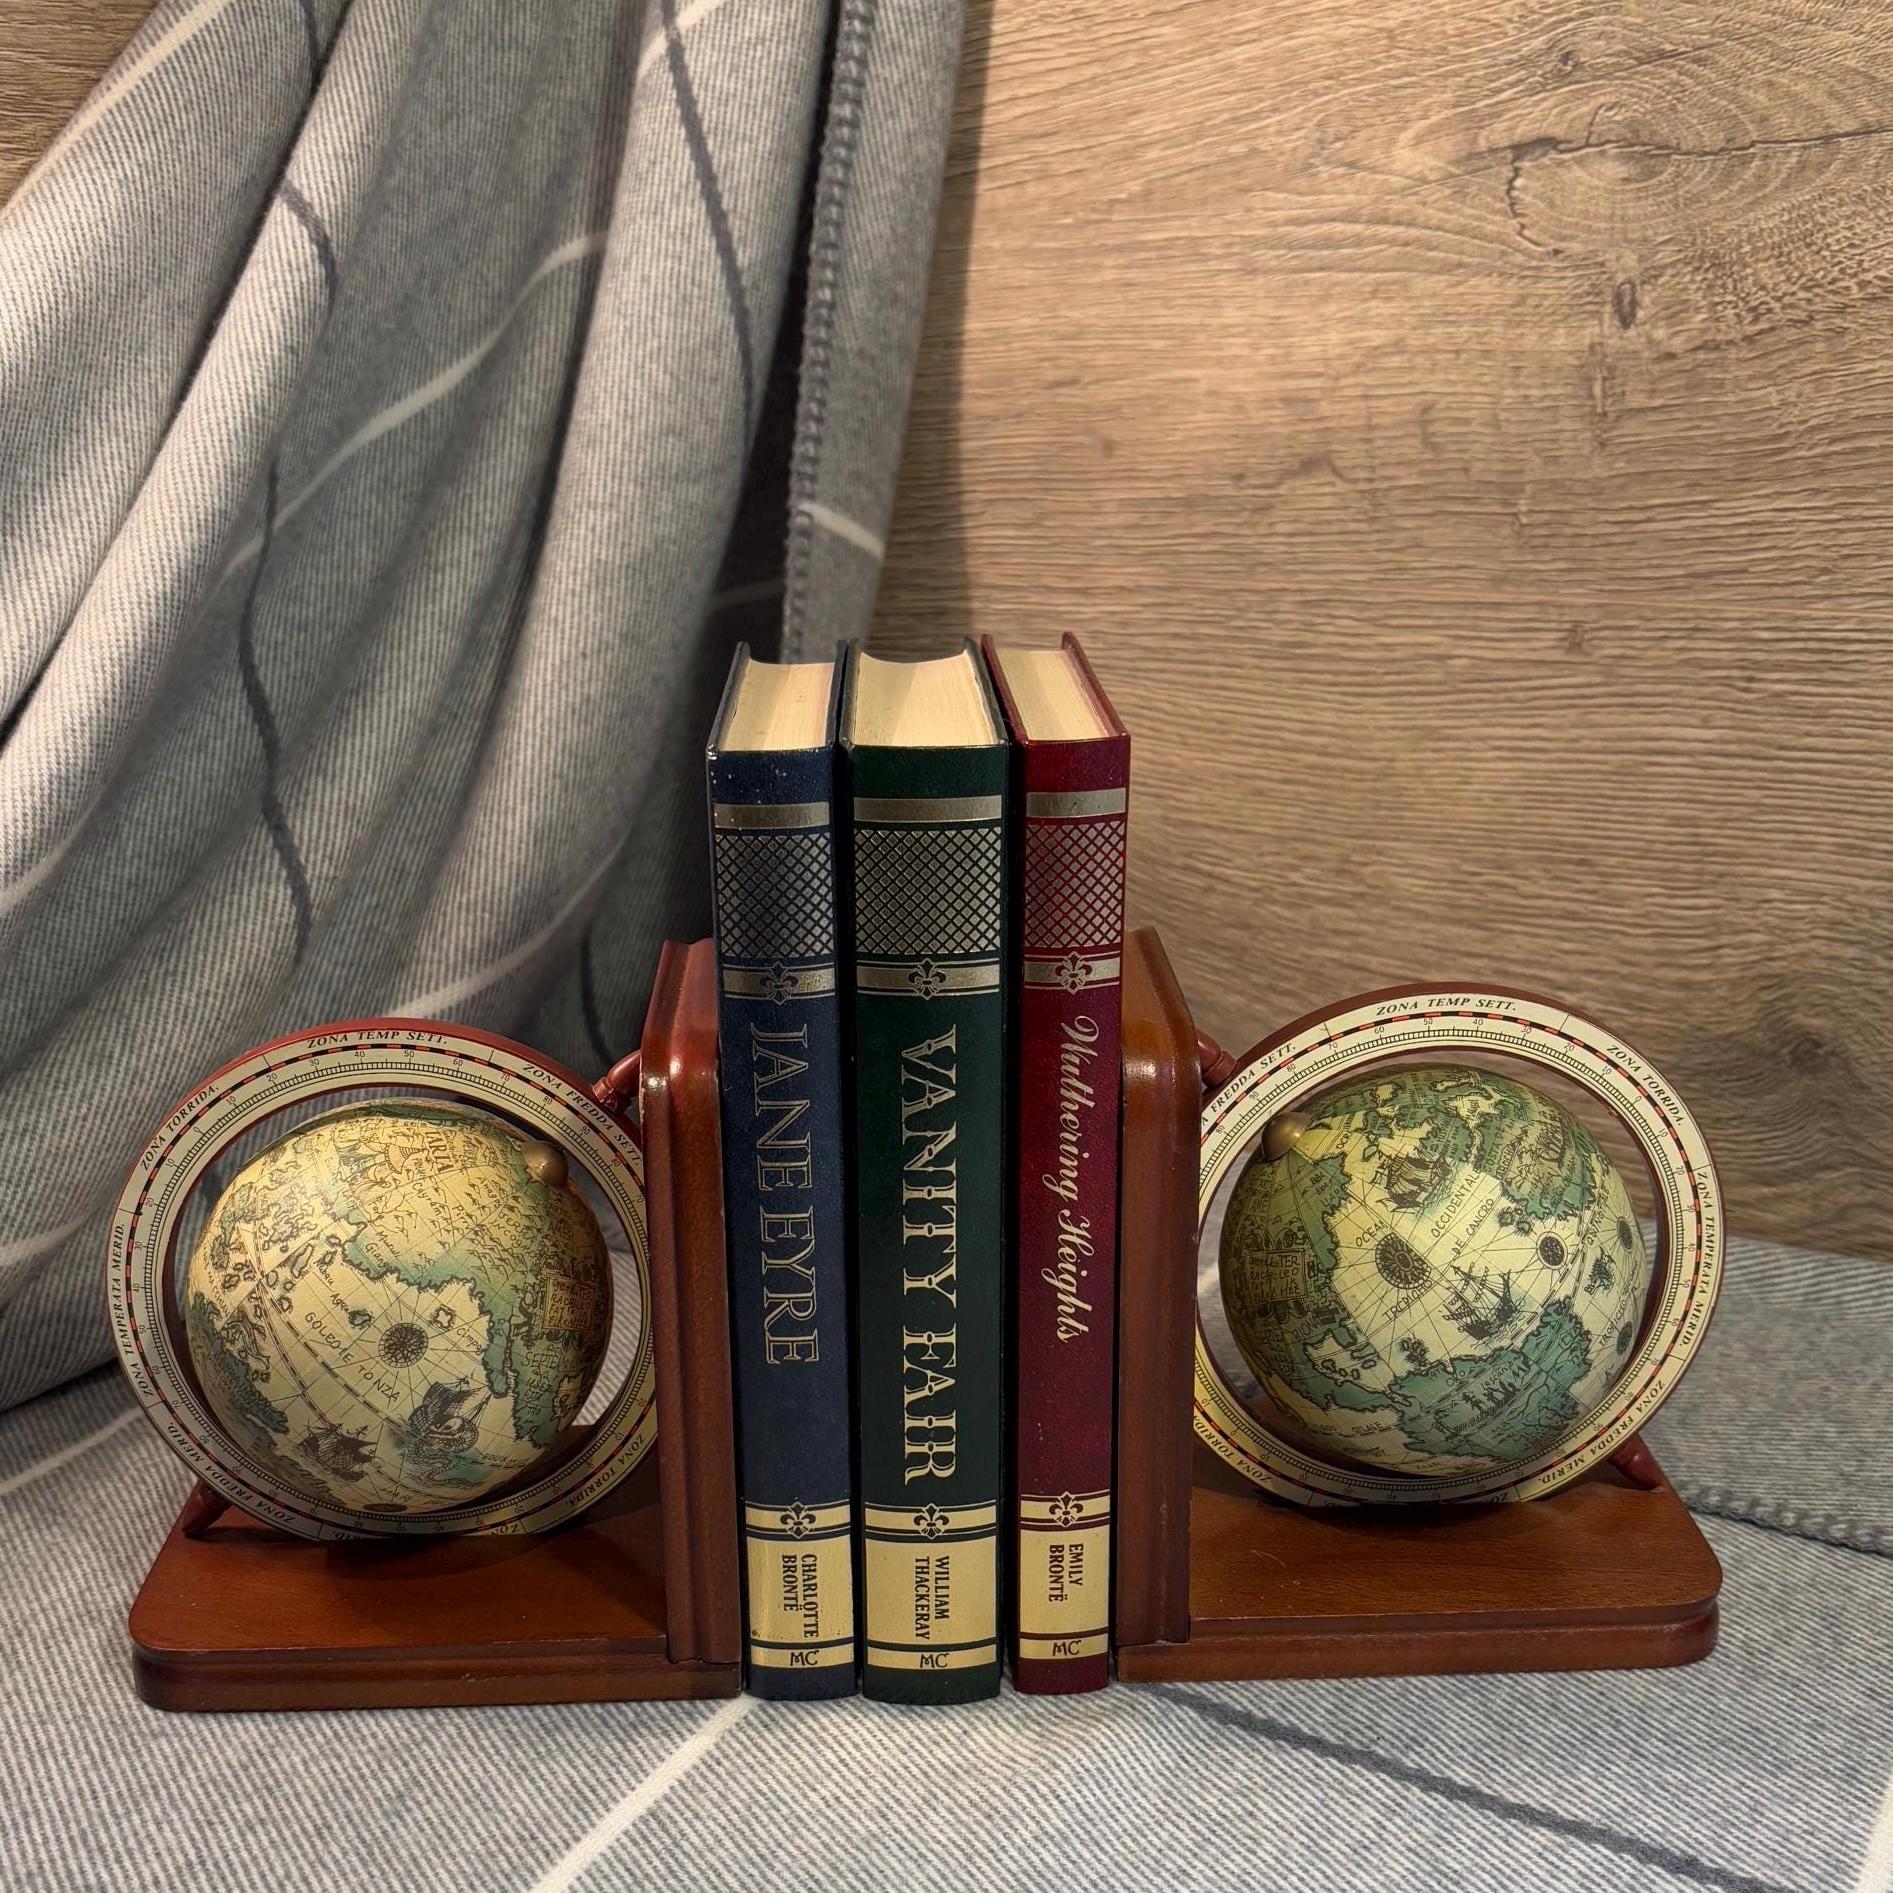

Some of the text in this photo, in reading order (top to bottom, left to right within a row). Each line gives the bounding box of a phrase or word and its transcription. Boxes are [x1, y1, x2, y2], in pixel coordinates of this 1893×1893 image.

[1376, 998, 1517, 1016] ZONA TEMP SETT.
[1423, 1018, 1433, 1026] 50
[1473, 1018, 1484, 1026] 40
[1374, 1026, 1385, 1034] 60
[1521, 1026, 1532, 1034] 30
[307, 1030, 448, 1049] ZONA TEMP SETT.
[1564, 1043, 1575, 1051] 20
[354, 1051, 366, 1059] 40
[404, 1050, 415, 1058] 50
[453, 1059, 463, 1067] 60
[1287, 1063, 1297, 1072] 80
[1602, 1066, 1612, 1075] 10
[266, 1073, 278, 1082] 20
[501, 1073, 510, 1081] 70
[1210, 1042, 1296, 1113] FREDDA SETT.
[1606, 1044, 1685, 1126] ZONA TORRIDA.
[226, 1095, 236, 1105] 10
[544, 1096, 553, 1104] 80
[1249, 1091, 1259, 1100] 90
[522, 1063, 641, 1166] ZONA FREDDA SETT.
[140, 1085, 220, 1172] ZONA TORRIDA.
[582, 1126, 591, 1135] 90
[1215, 1125, 1225, 1134] 80
[1659, 1128, 1668, 1137] 10
[165, 1158, 175, 1168] 10
[1676, 1166, 1685, 1176] 20
[1042, 1015, 1099, 1344] Wuthering Heights
[751, 1022, 819, 1364] JANE EYRE
[146, 1197, 154, 1207] 20
[134, 1241, 143, 1250] 30
[1688, 1243, 1696, 1252] 40
[902, 1024, 956, 1486] VANITY FAIR
[1680, 1171, 1715, 1347] ZONA TEMPERATA MERID.
[133, 1283, 140, 1293] 40
[1684, 1279, 1691, 1289] 50
[111, 1223, 154, 1398] ZONA TEMPERATA MERID.
[1672, 1318, 1680, 1327] 60
[140, 1324, 147, 1334] 50
[1538, 1379, 1665, 1484] ZONA FREDDA MERID.
[167, 1422, 297, 1522] ZONA FREDDA MERID.
[566, 1434, 645, 1507] ZONA TORRIDA.
[1236, 1459, 1273, 1483] ZONA
[1068, 1543, 1084, 1586] EMILY
[1048, 1544, 1068, 1603] BRONTË
[781, 1554, 802, 1612] BRONTË
[933, 1555, 950, 1620] WILLIAM
[800, 1553, 819, 1638] CHARLOTTE
[914, 1556, 931, 1640] THACKERAY
[1052, 1640, 1081, 1656] MC
[790, 1651, 820, 1667] MC
[920, 1652, 948, 1669] MC
